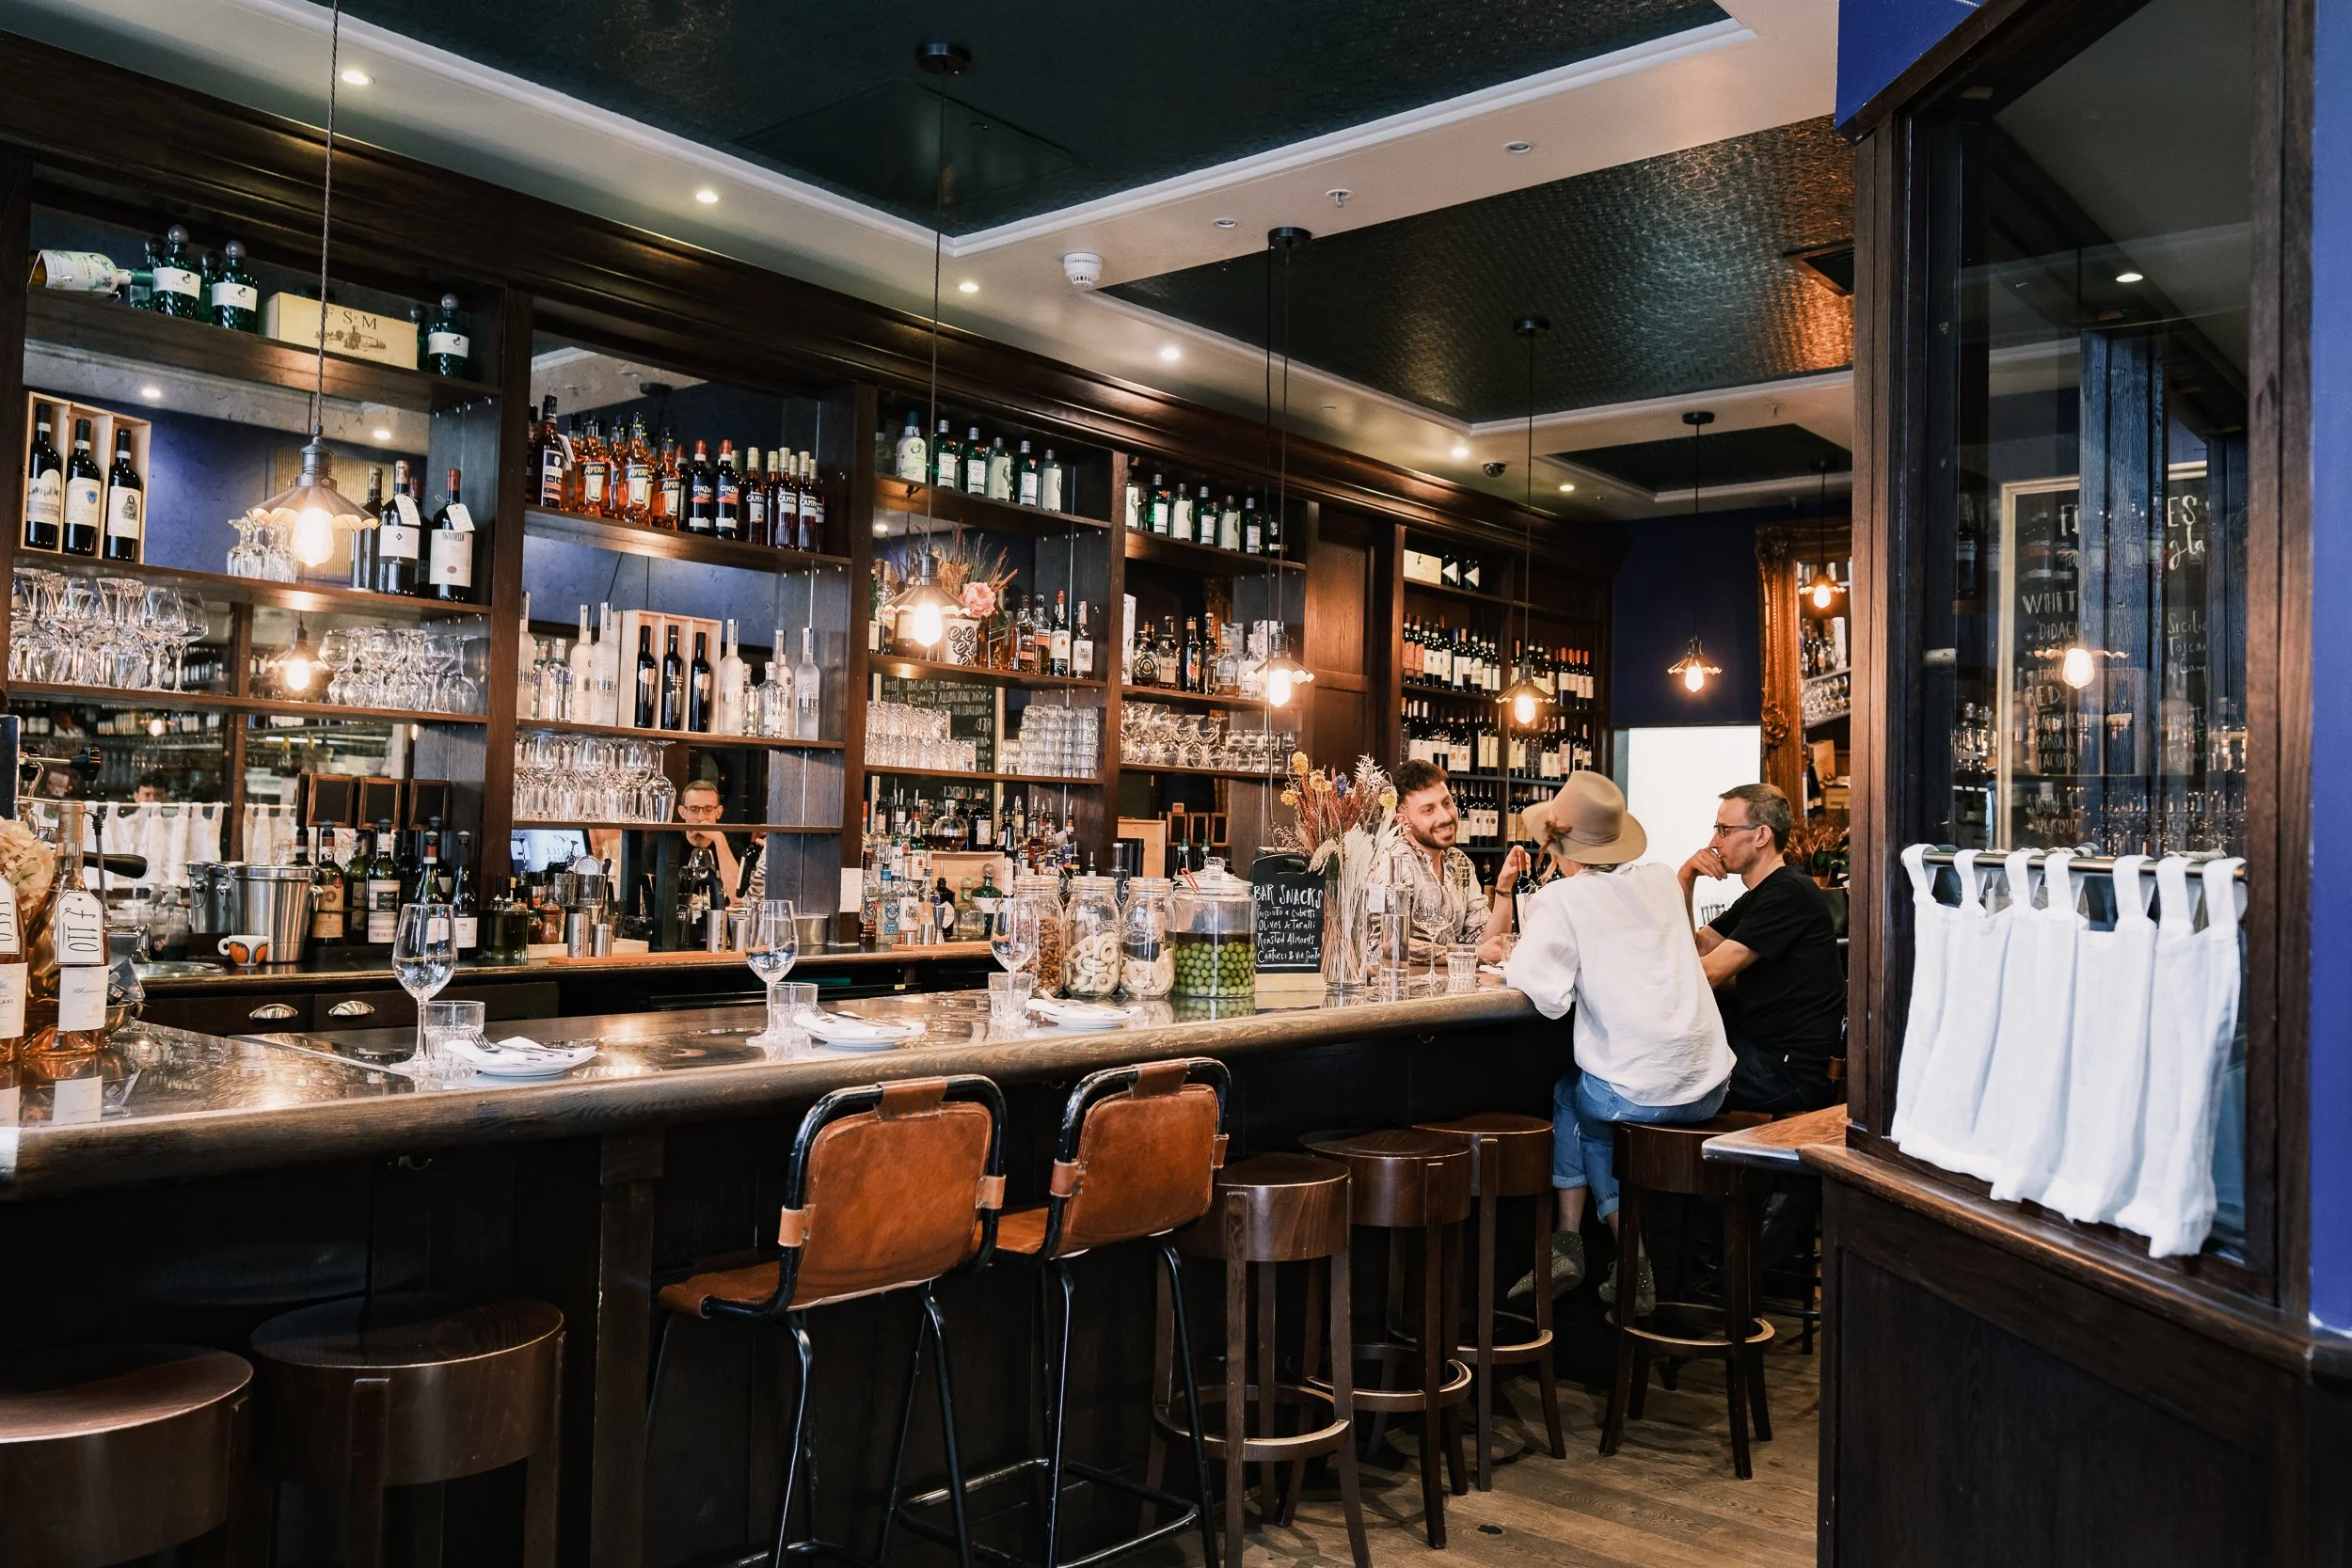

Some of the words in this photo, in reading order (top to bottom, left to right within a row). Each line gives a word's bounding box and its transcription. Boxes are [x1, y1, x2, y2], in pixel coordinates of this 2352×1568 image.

[2022, 590, 2077, 615] WHIT
[1253, 883, 1274, 905] BAR
[1279, 884, 1324, 910] SNACKS
